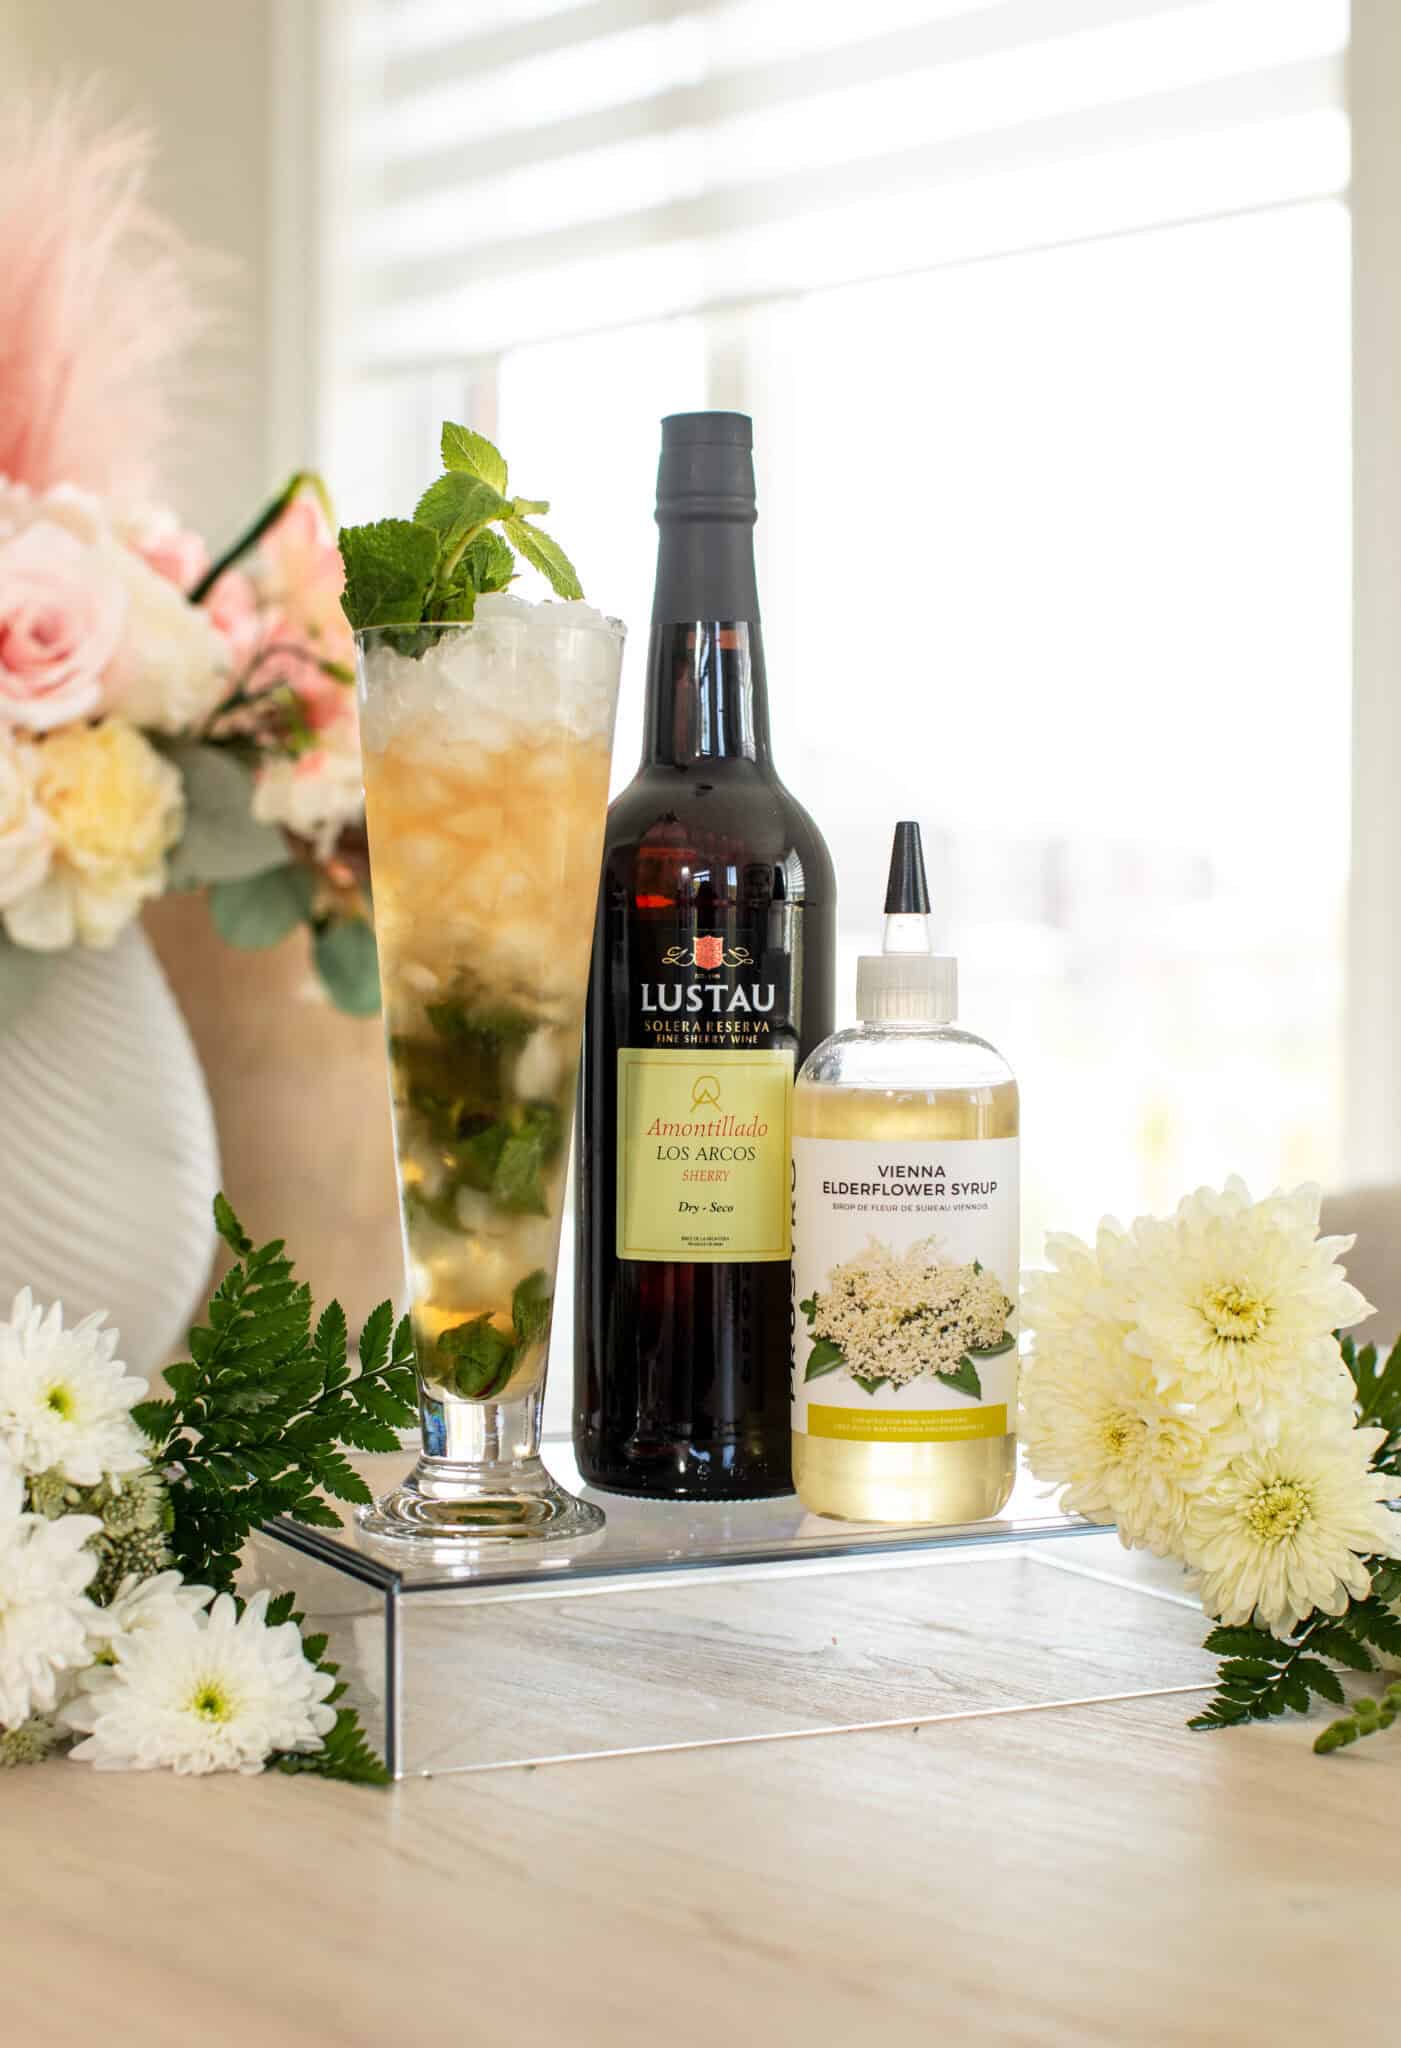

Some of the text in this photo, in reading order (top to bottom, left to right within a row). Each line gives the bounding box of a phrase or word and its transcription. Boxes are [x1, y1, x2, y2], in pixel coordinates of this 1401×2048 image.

[641, 984, 775, 1012] LUSTAU
[644, 1021, 770, 1032] SOLERA RESERVA
[657, 1034, 758, 1044] FINE SHERRY WINE
[647, 1115, 768, 1137] Amontillado
[656, 1145, 757, 1160] LOS ARCOS
[682, 1169, 730, 1182] SHERRY
[877, 1165, 946, 1178] VIENNA
[823, 1181, 998, 1196] ELDERFLOWER SYRUP
[678, 1202, 699, 1214] Dry
[709, 1202, 734, 1213] Seco
